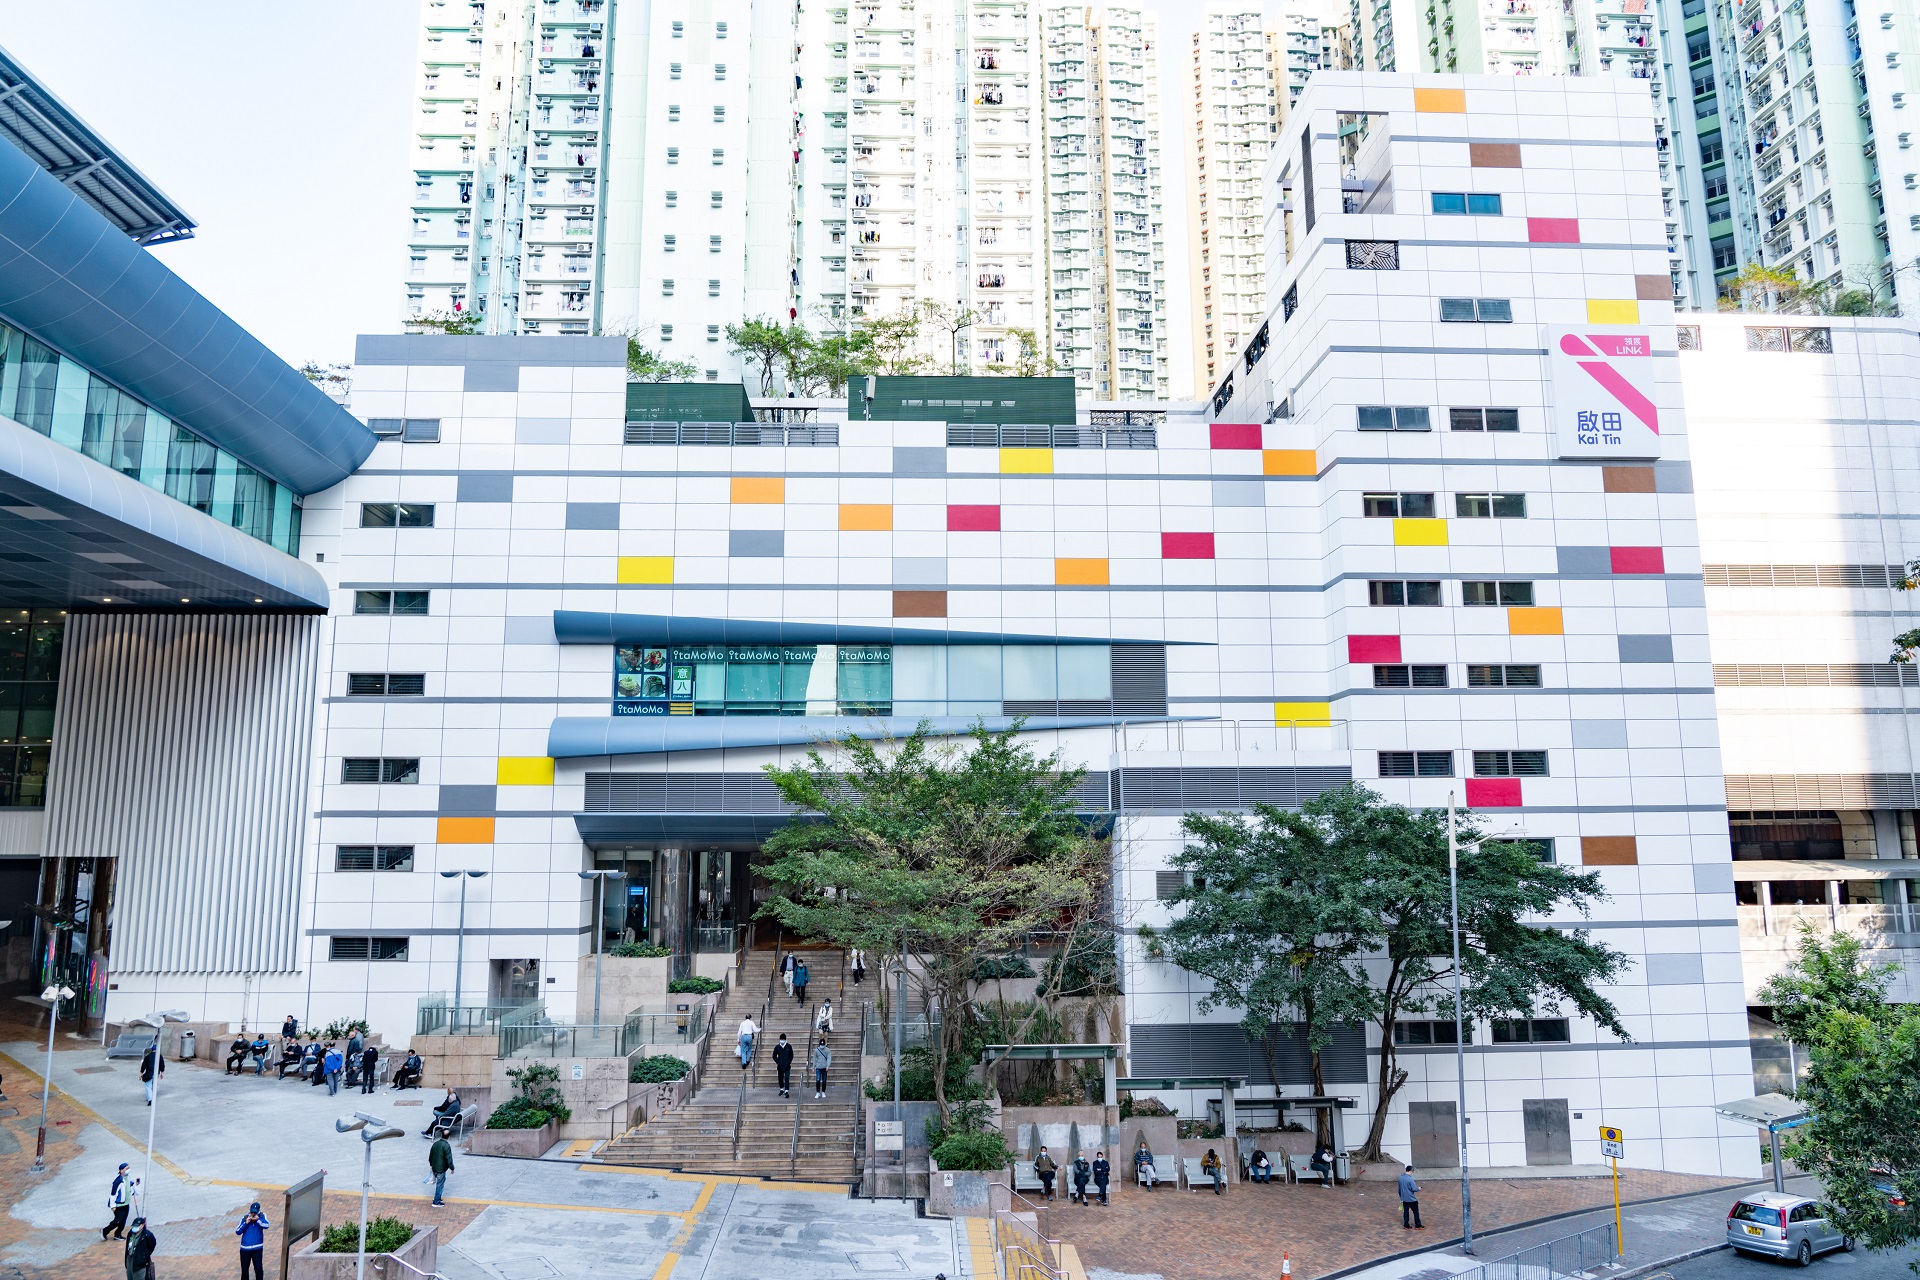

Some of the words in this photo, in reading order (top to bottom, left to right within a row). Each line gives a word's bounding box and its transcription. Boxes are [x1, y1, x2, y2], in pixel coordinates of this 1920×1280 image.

[1624, 337, 1642, 346] 領展
[1616, 346, 1643, 355] LINK
[1577, 410, 1622, 432] 啟田
[1578, 433, 1599, 445] Kai
[1602, 433, 1621, 445] Tin
